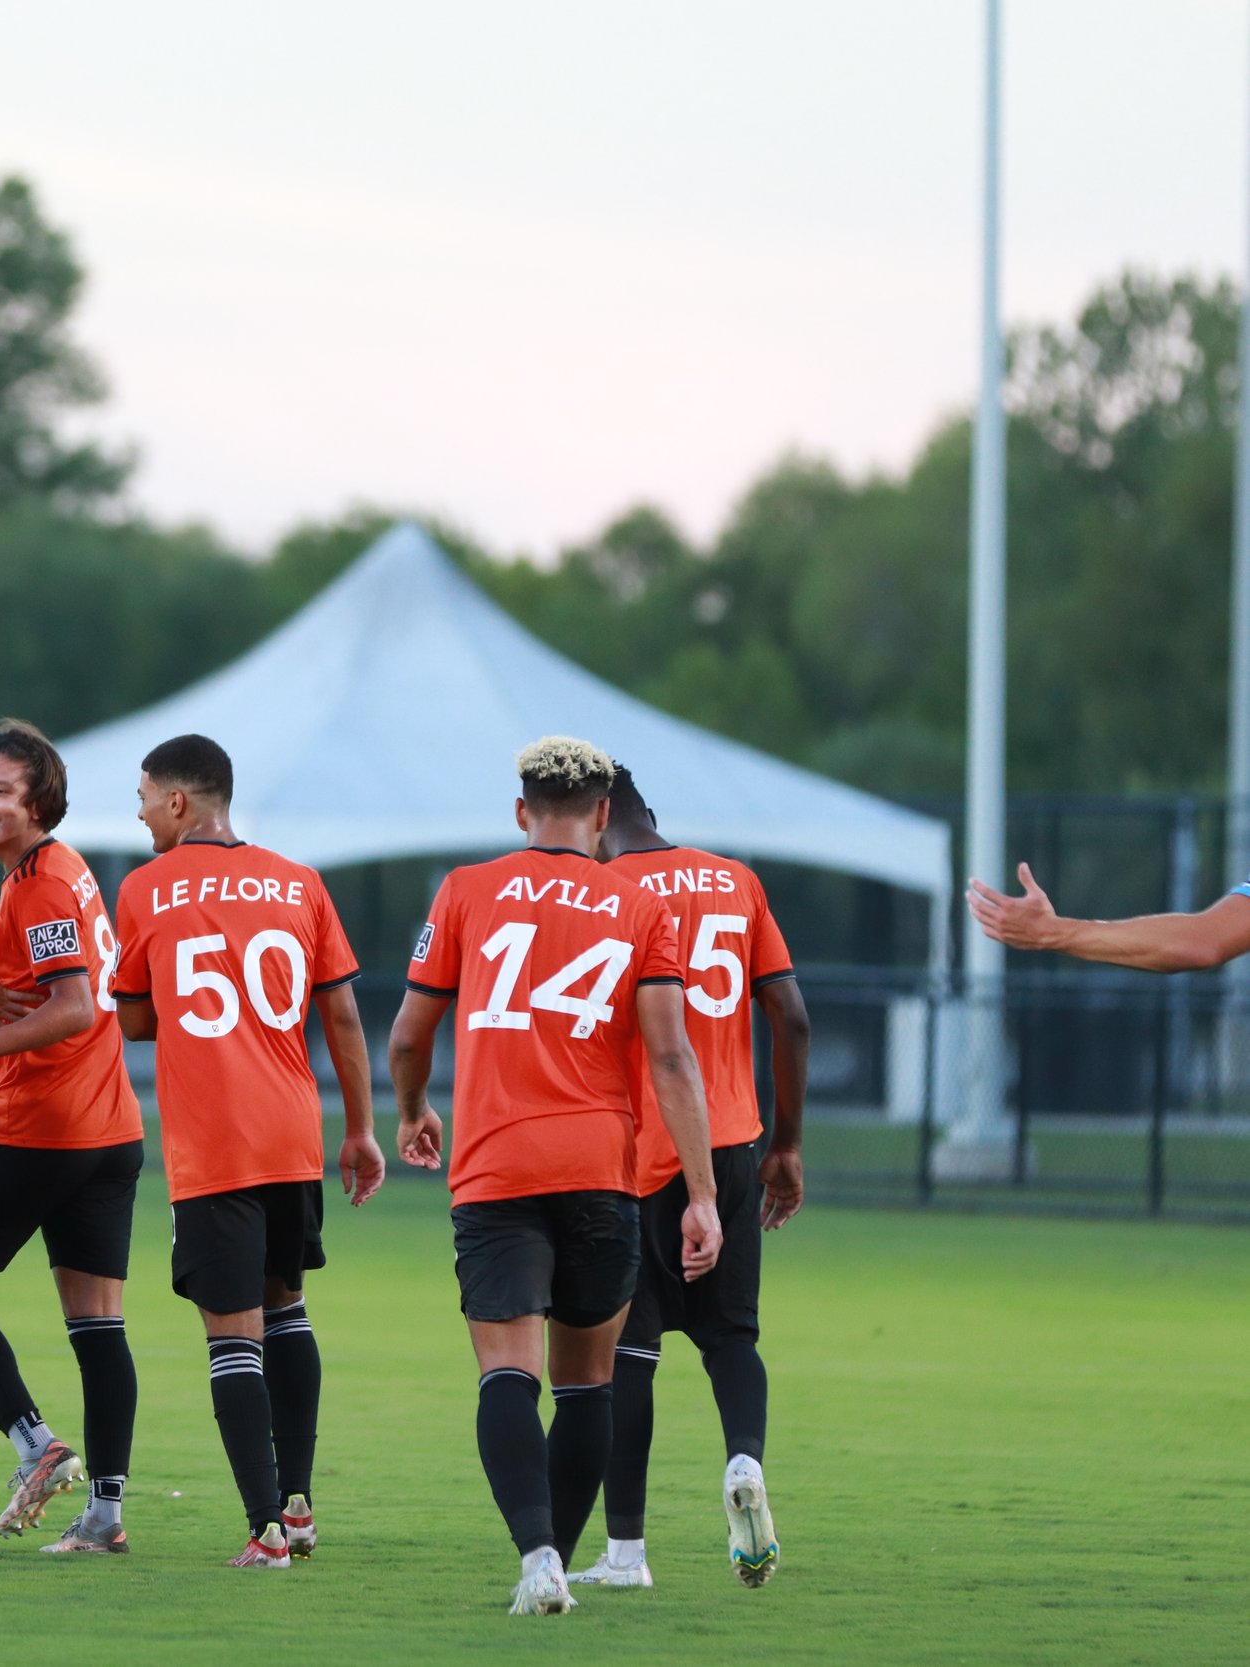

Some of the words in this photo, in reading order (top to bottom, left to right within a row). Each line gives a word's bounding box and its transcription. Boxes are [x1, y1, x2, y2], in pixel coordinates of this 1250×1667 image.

[152, 879, 190, 915] LE
[198, 876, 304, 906] FLORE
[495, 876, 621, 918] AVILA
[37, 922, 73, 944] NEXT
[45, 937, 77, 955] PRO
[175, 929, 307, 1039] 50
[468, 921, 635, 1039] 14
[674, 914, 749, 1018] 5
